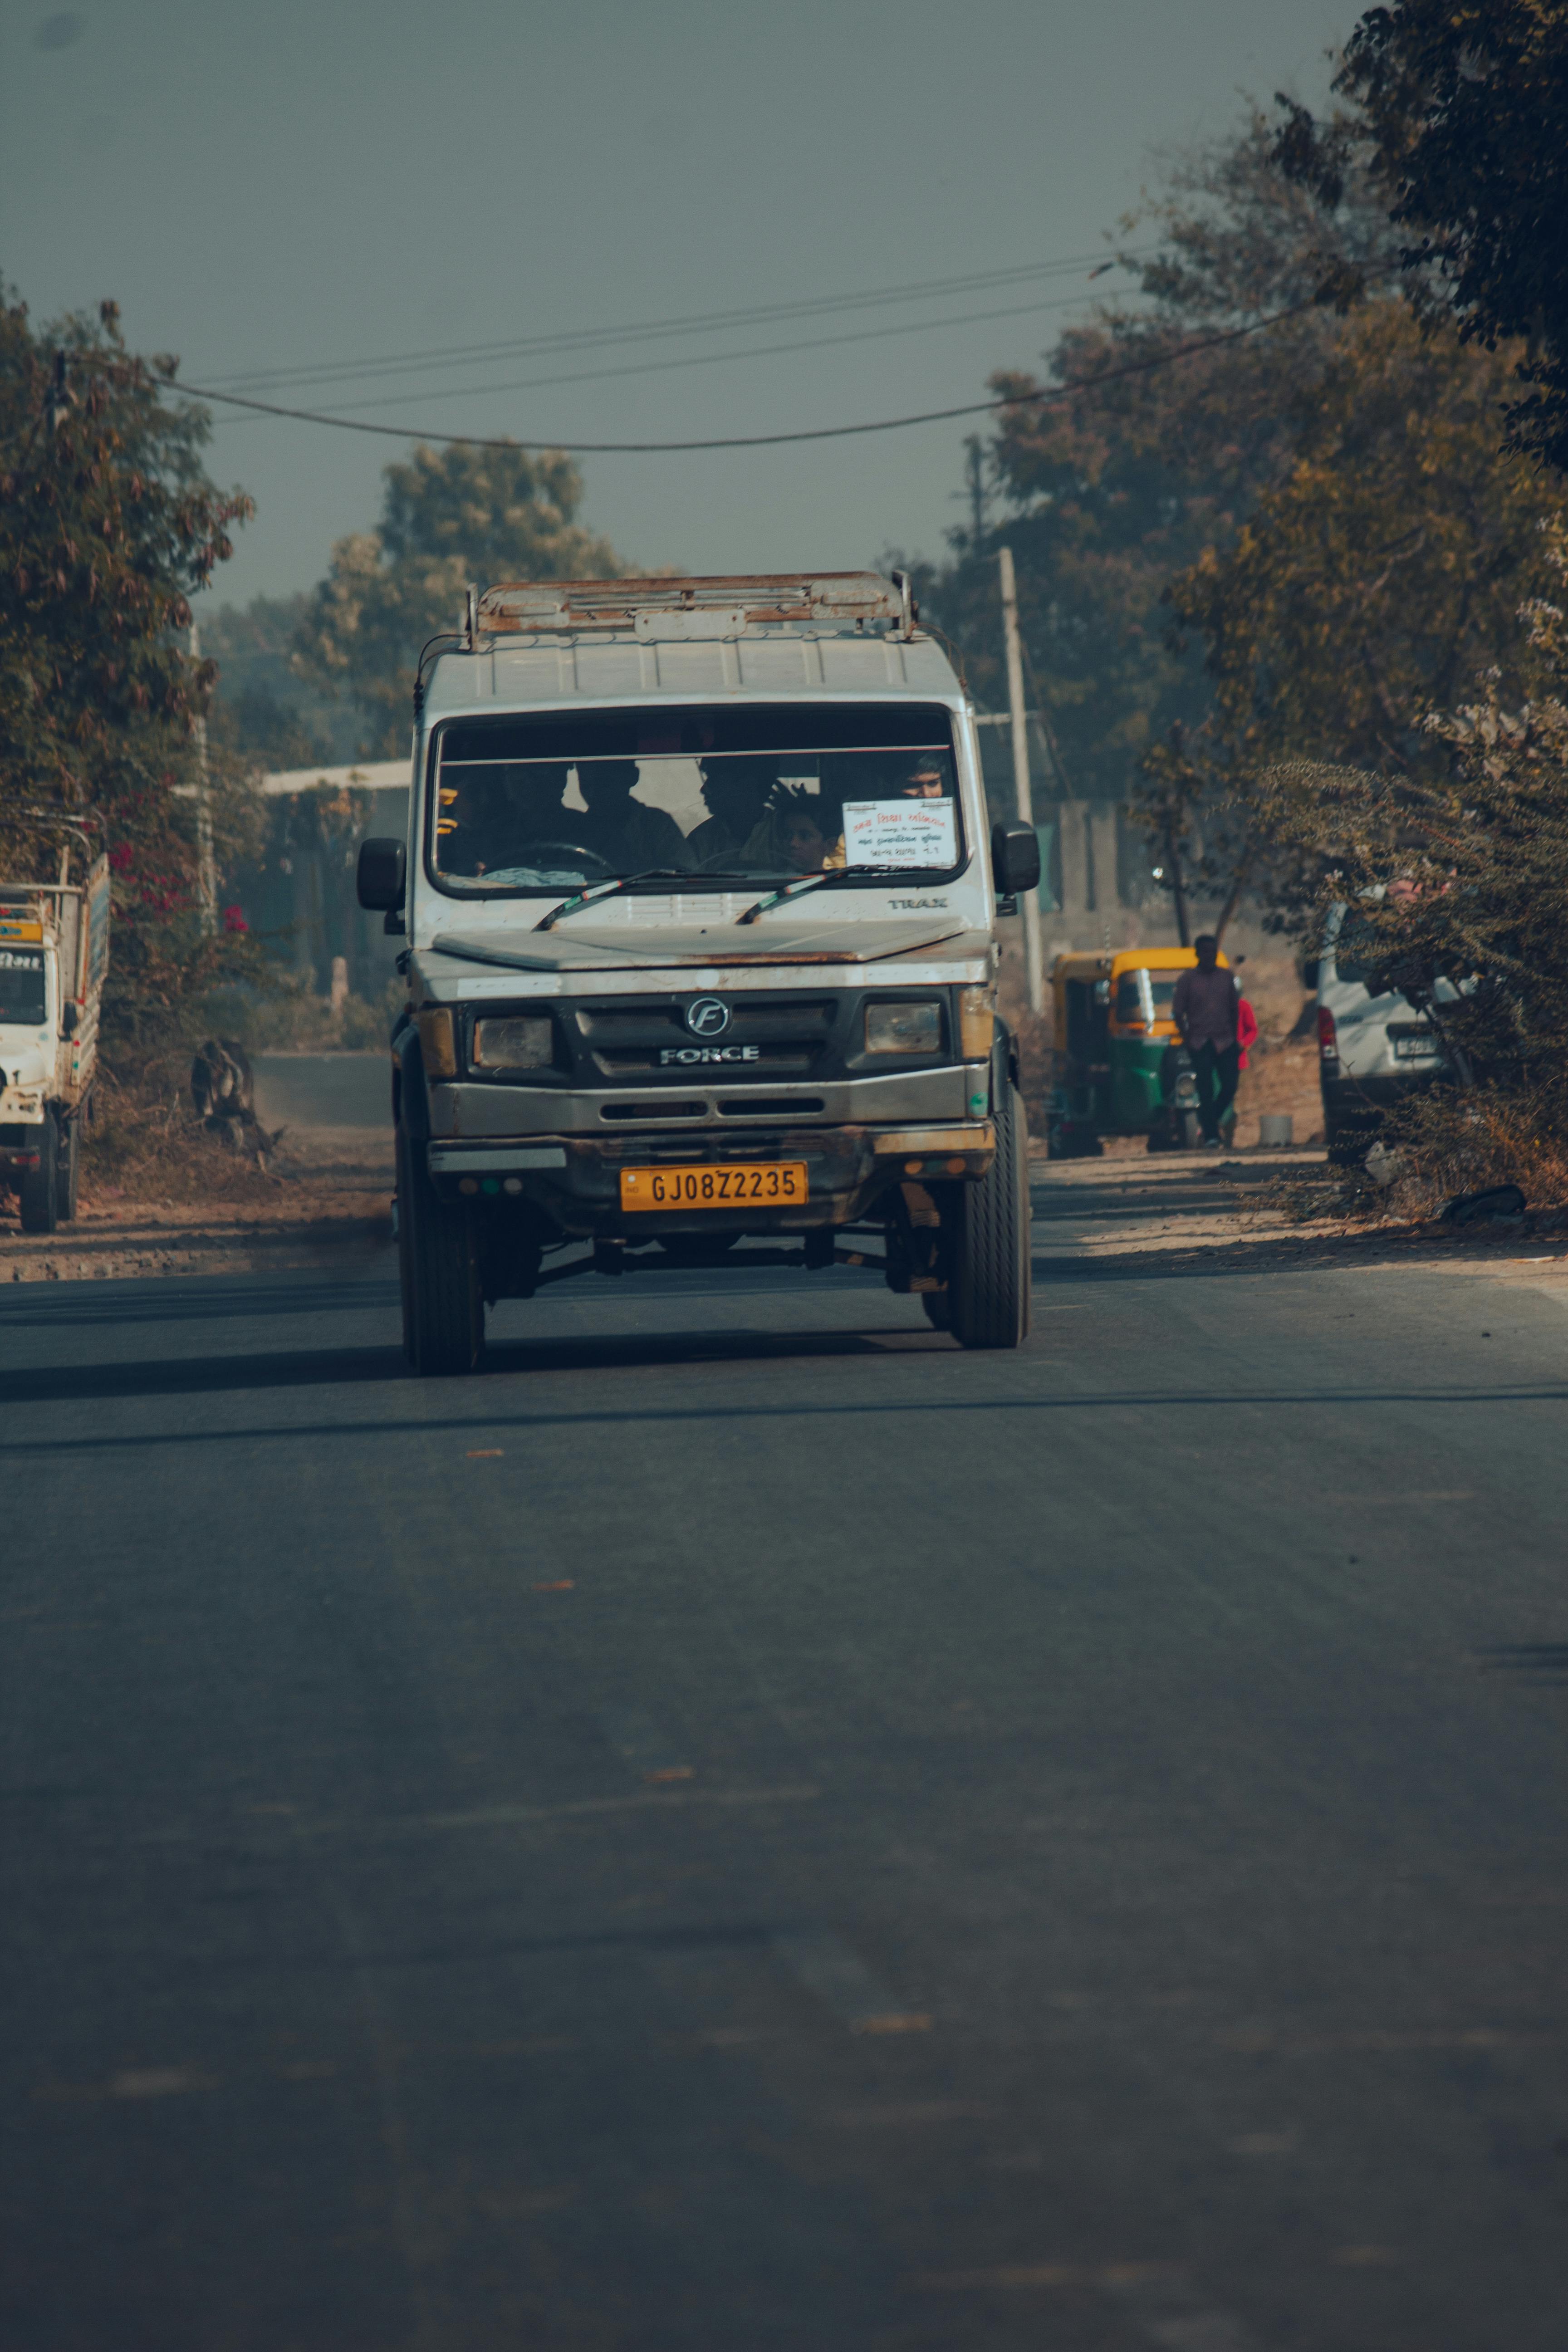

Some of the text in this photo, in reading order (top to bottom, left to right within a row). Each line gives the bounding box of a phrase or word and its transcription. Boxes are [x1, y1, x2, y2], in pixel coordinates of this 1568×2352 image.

[887, 898, 948, 909] TRAX
[660, 1045, 760, 1064] FORCE
[652, 1170, 796, 1201] GJ08Z2235
